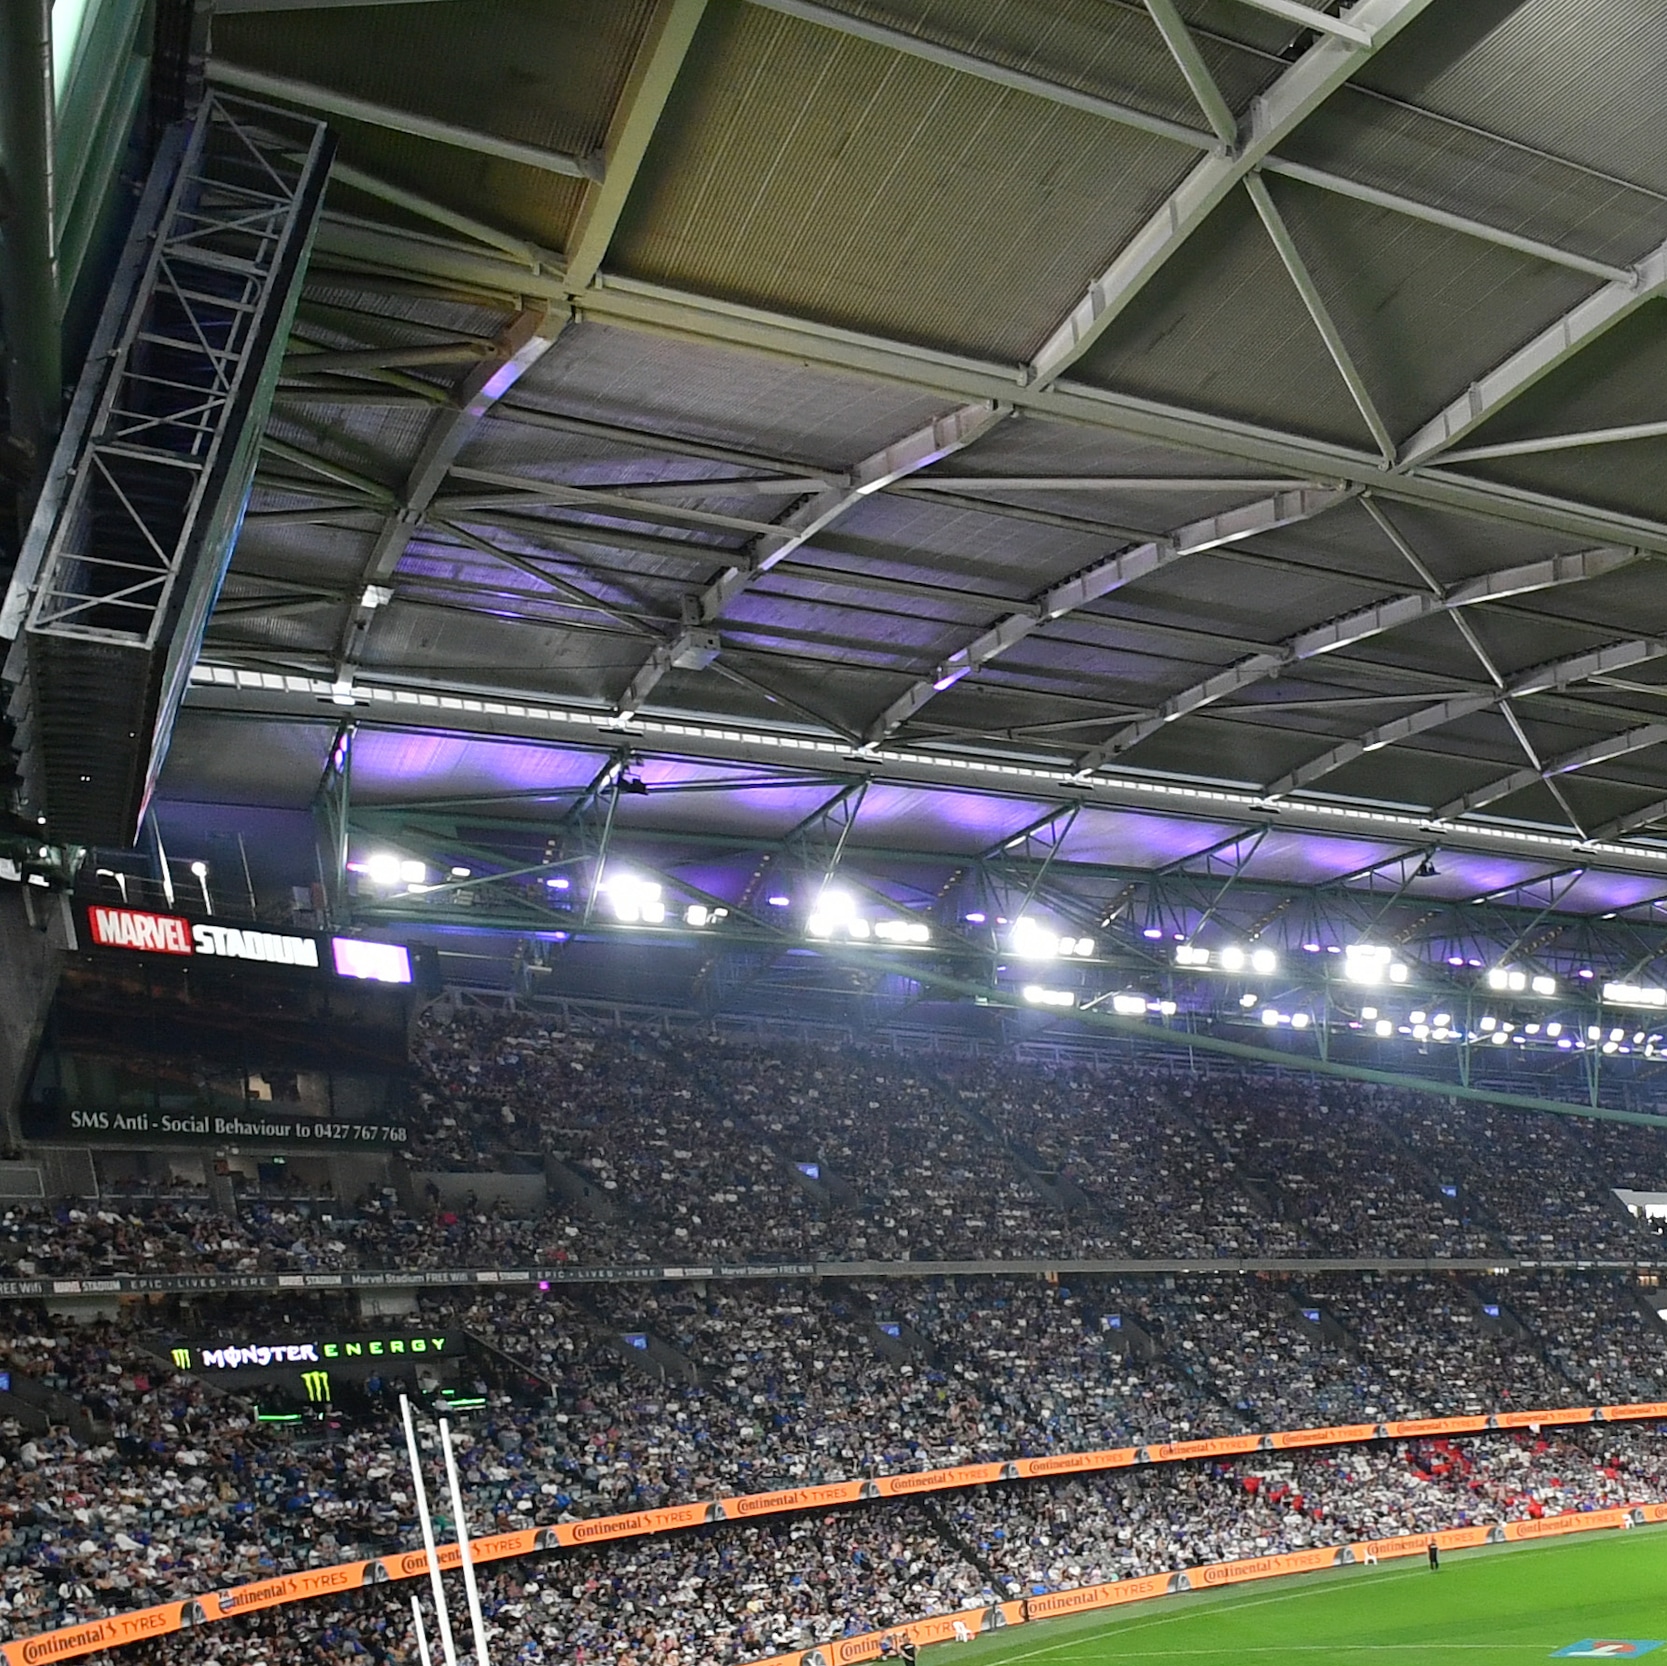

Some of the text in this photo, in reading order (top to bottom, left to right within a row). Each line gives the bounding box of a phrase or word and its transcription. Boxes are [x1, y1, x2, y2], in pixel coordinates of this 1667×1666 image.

[95, 908, 319, 968] MARVEL STADIUM
[70, 1110, 109, 1130] SMS
[113, 1113, 148, 1132] Anti
[161, 1114, 210, 1134] Social
[214, 1117, 292, 1138] Behaviour
[295, 1123, 311, 1139] to
[314, 1124, 350, 1140] 0427
[352, 1125, 381, 1141] 767
[381, 1126, 408, 1142] 768
[130, 1280, 162, 1290] EPIC
[230, 1276, 267, 1287] HERE
[352, 1273, 384, 1284] Marvel
[384, 1273, 424, 1284] Stadium
[425, 1273, 450, 1283] FREE
[203, 1337, 447, 1369] MONSTER ENERGY
[1506, 1411, 1556, 1426] Continental
[1611, 1404, 1652, 1418] Continental
[1282, 1428, 1365, 1446] Continental TYRES
[1397, 1419, 1477, 1434] Continental TYRES
[1159, 1440, 1248, 1459] Continental TYRES
[1028, 1453, 1125, 1475] Continental TYRES
[890, 1469, 990, 1493] Continental TYRES
[737, 1487, 848, 1515] Continental TYRES
[572, 1510, 693, 1542] Continental TYRES
[1516, 1512, 1617, 1538] Continental TYRES
[1367, 1537, 1431, 1557] Continental
[302, 1571, 348, 1589] TYRES
[1204, 1553, 1322, 1584] Continental TYRES
[1019, 1581, 1154, 1618] Continental TYRES
[22, 1613, 166, 1665] Continental TYRES
